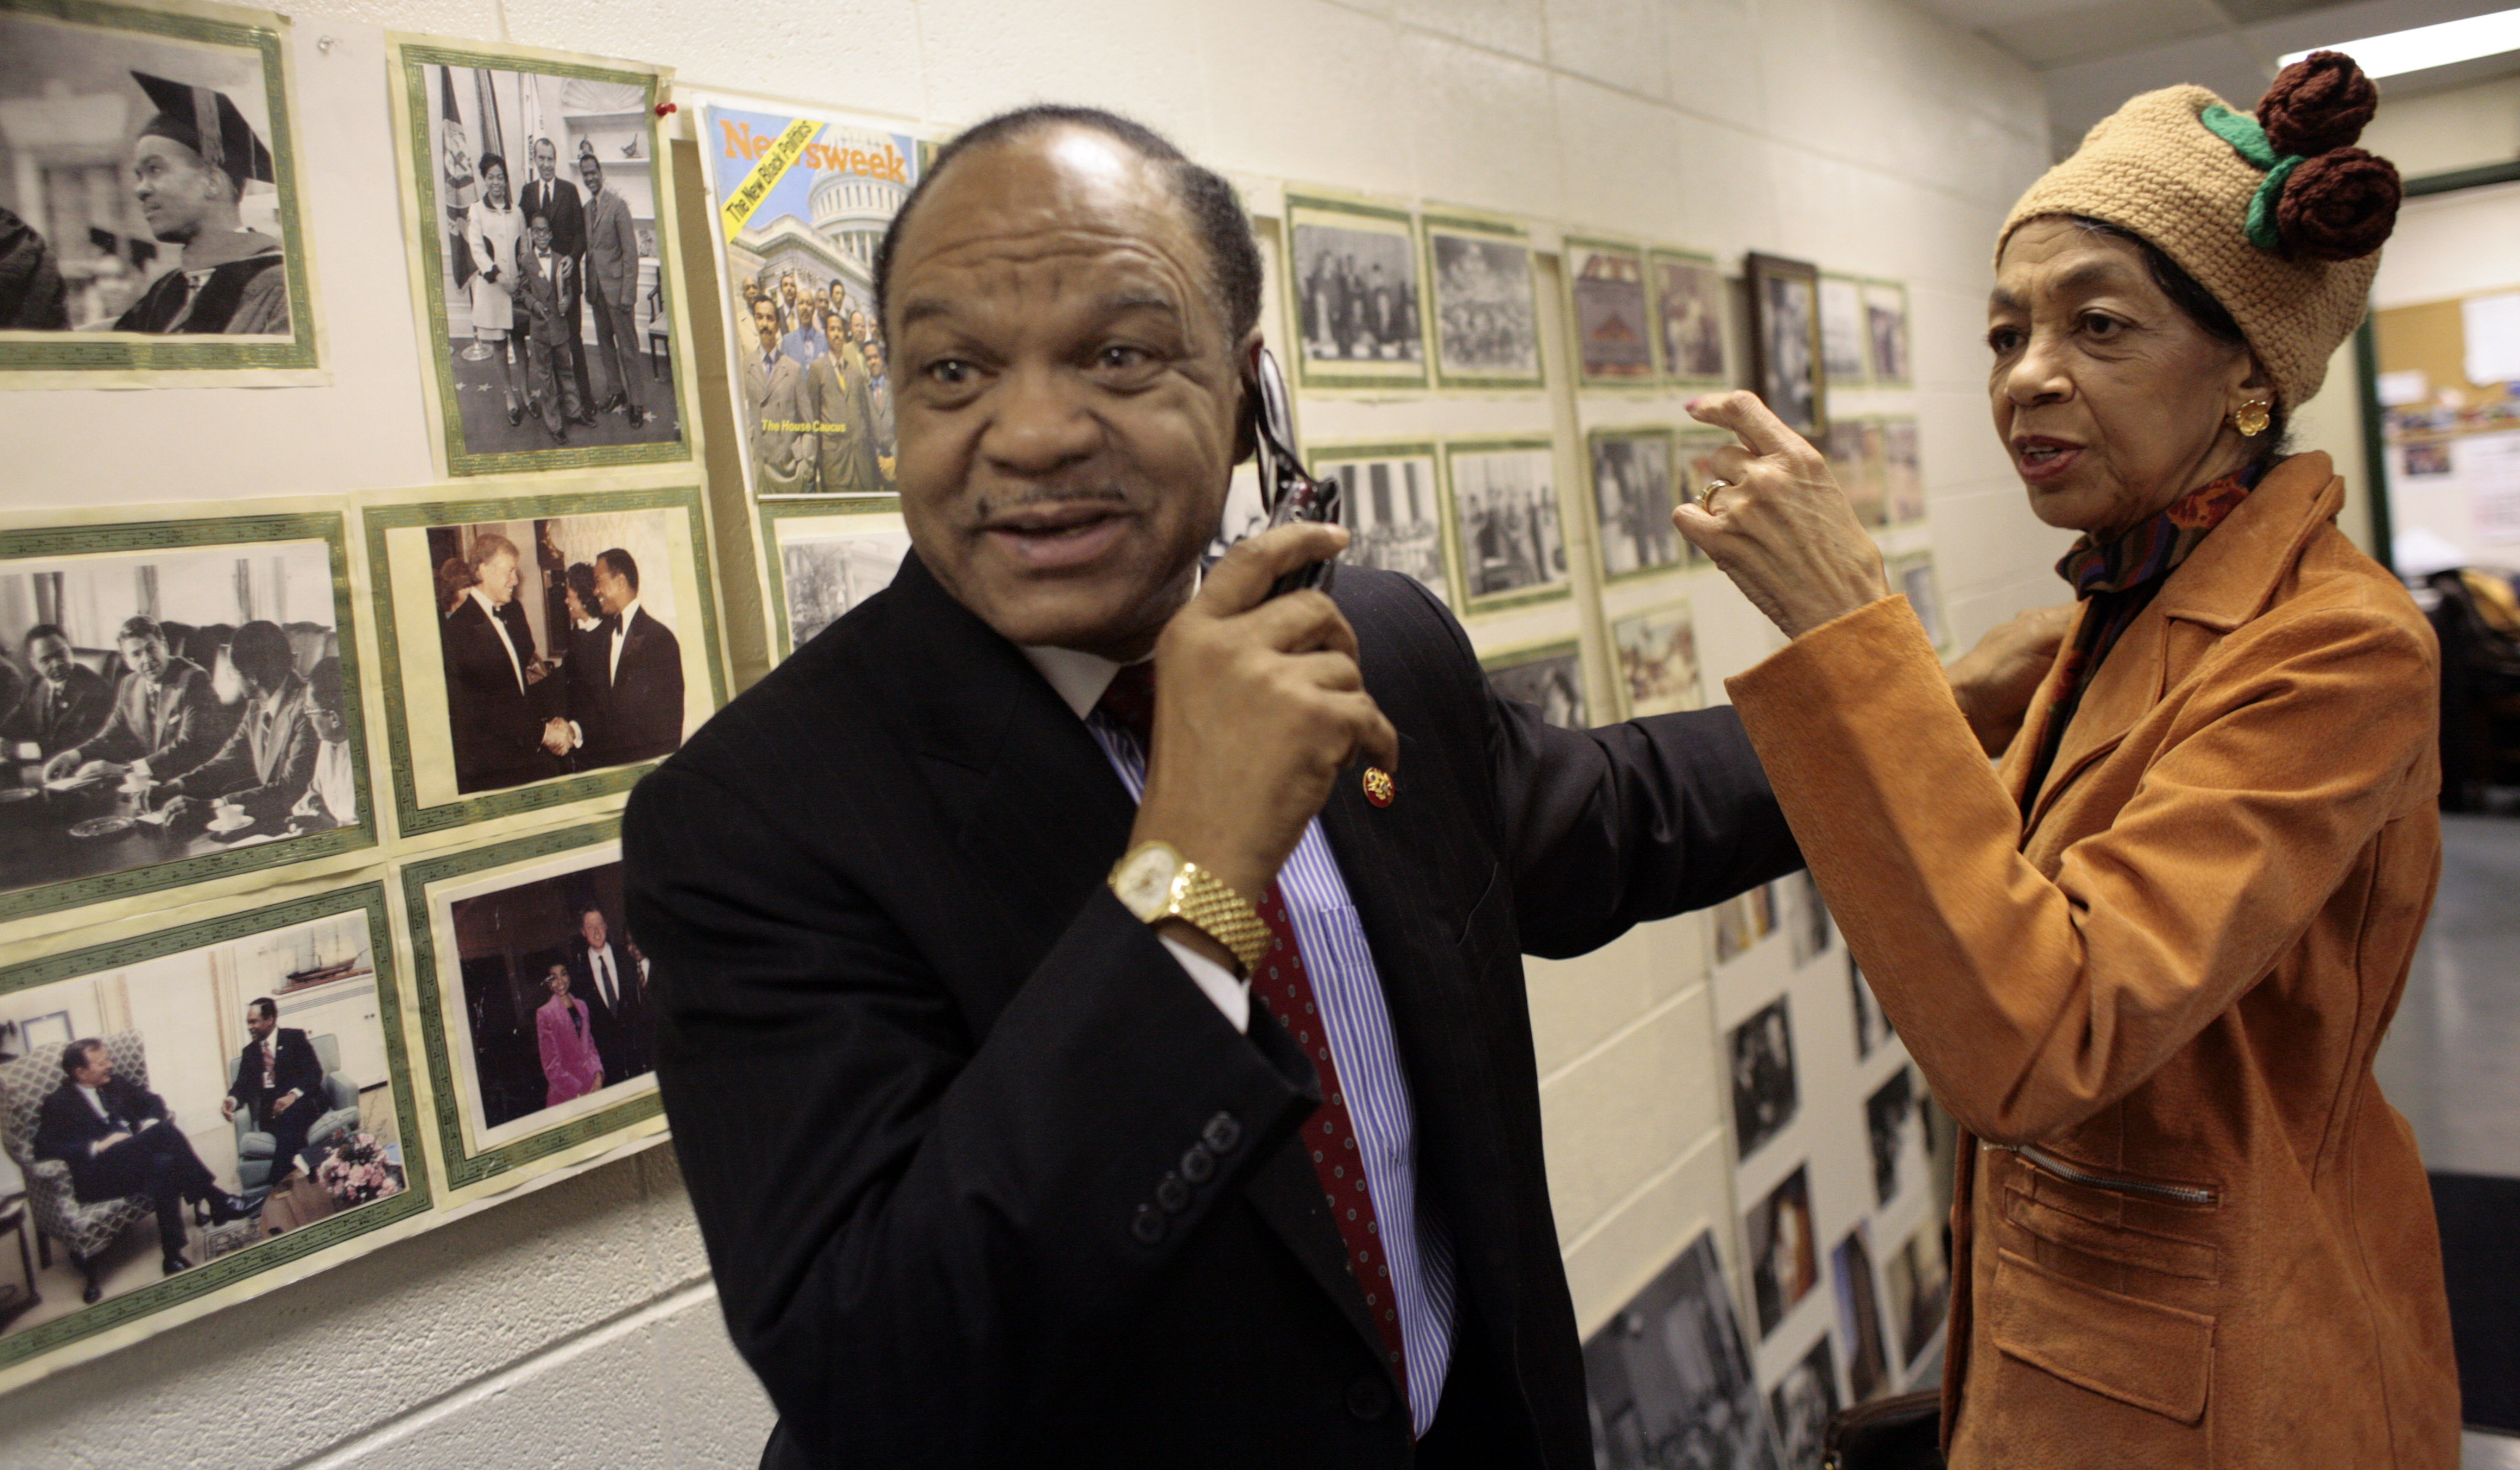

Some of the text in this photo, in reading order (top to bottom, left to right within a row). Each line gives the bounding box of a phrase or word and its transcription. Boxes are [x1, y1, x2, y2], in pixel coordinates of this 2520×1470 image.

[726, 120, 812, 222] The New Black Politics
[762, 419, 847, 432] The House Caucus
